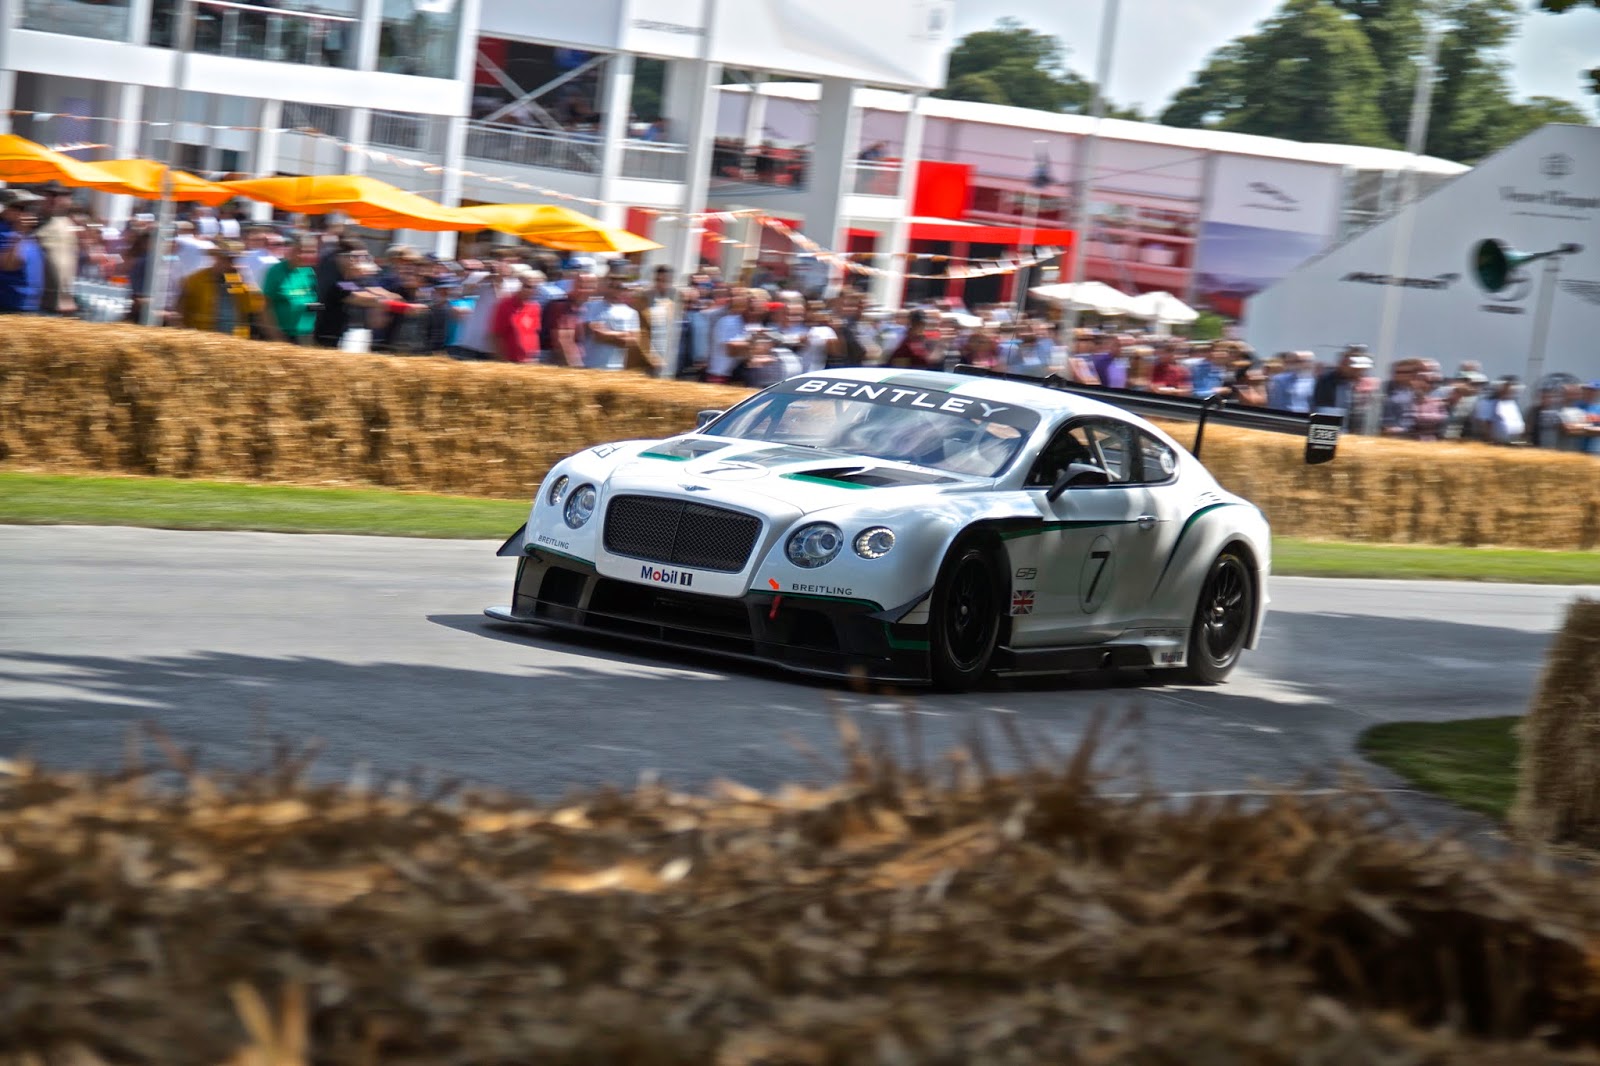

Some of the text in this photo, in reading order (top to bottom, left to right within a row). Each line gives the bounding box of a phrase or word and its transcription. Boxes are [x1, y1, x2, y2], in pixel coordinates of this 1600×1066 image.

[795, 379, 1010, 418] BENTLEY
[537, 534, 570, 550] BREITLING
[640, 565, 693, 586] Mobil 1
[1085, 551, 1111, 604] 7
[792, 583, 853, 596] BREITLING
